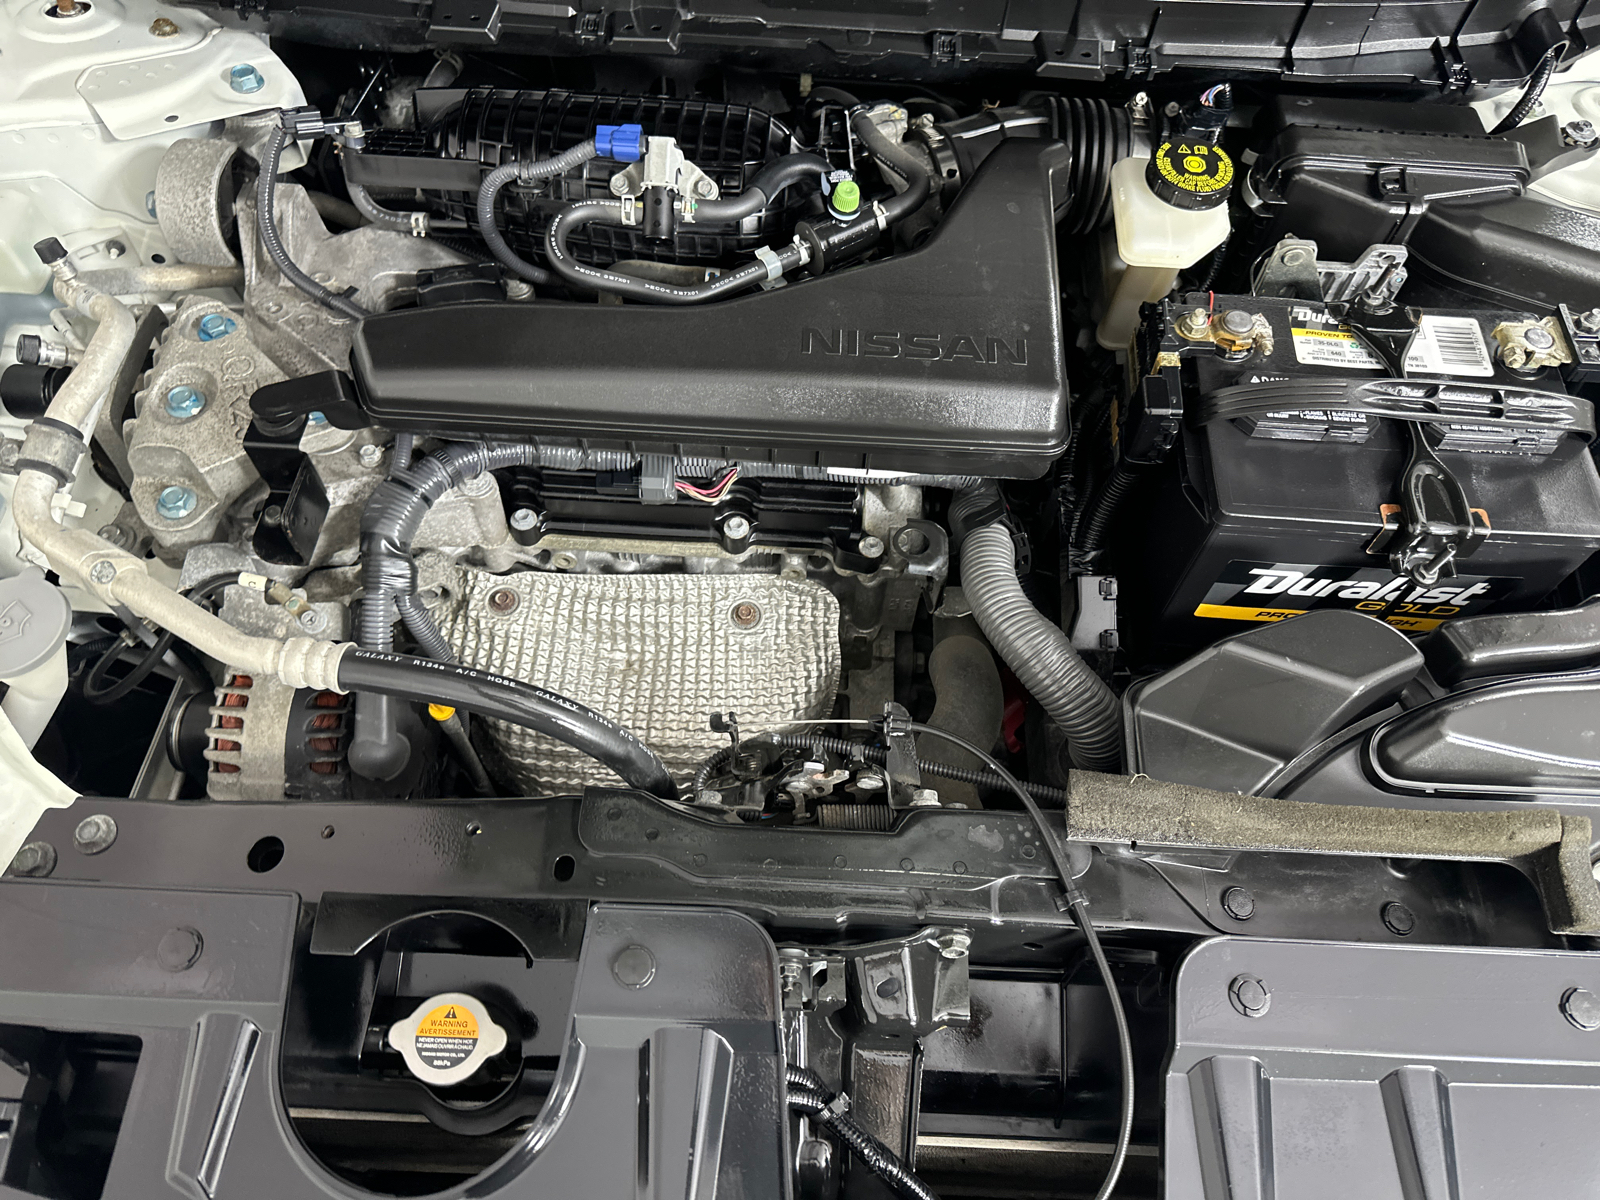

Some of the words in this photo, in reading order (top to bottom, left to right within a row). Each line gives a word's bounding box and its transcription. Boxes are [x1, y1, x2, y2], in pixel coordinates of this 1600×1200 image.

[1168, 169, 1185, 182] FILLER
[1197, 178, 1219, 187] BEFORE
[1184, 173, 1211, 182] WARNING
[1177, 182, 1195, 191] BRAKE
[801, 328, 1028, 366] NISSAN
[355, 651, 402, 662] GALAXY
[413, 660, 445, 670] R134a
[456, 668, 478, 677] A/C
[487, 675, 516, 688] HOSE
[535, 690, 580, 710] GALAXY
[620, 730, 633, 741] A/C
[431, 1020, 468, 1028] WARNING
